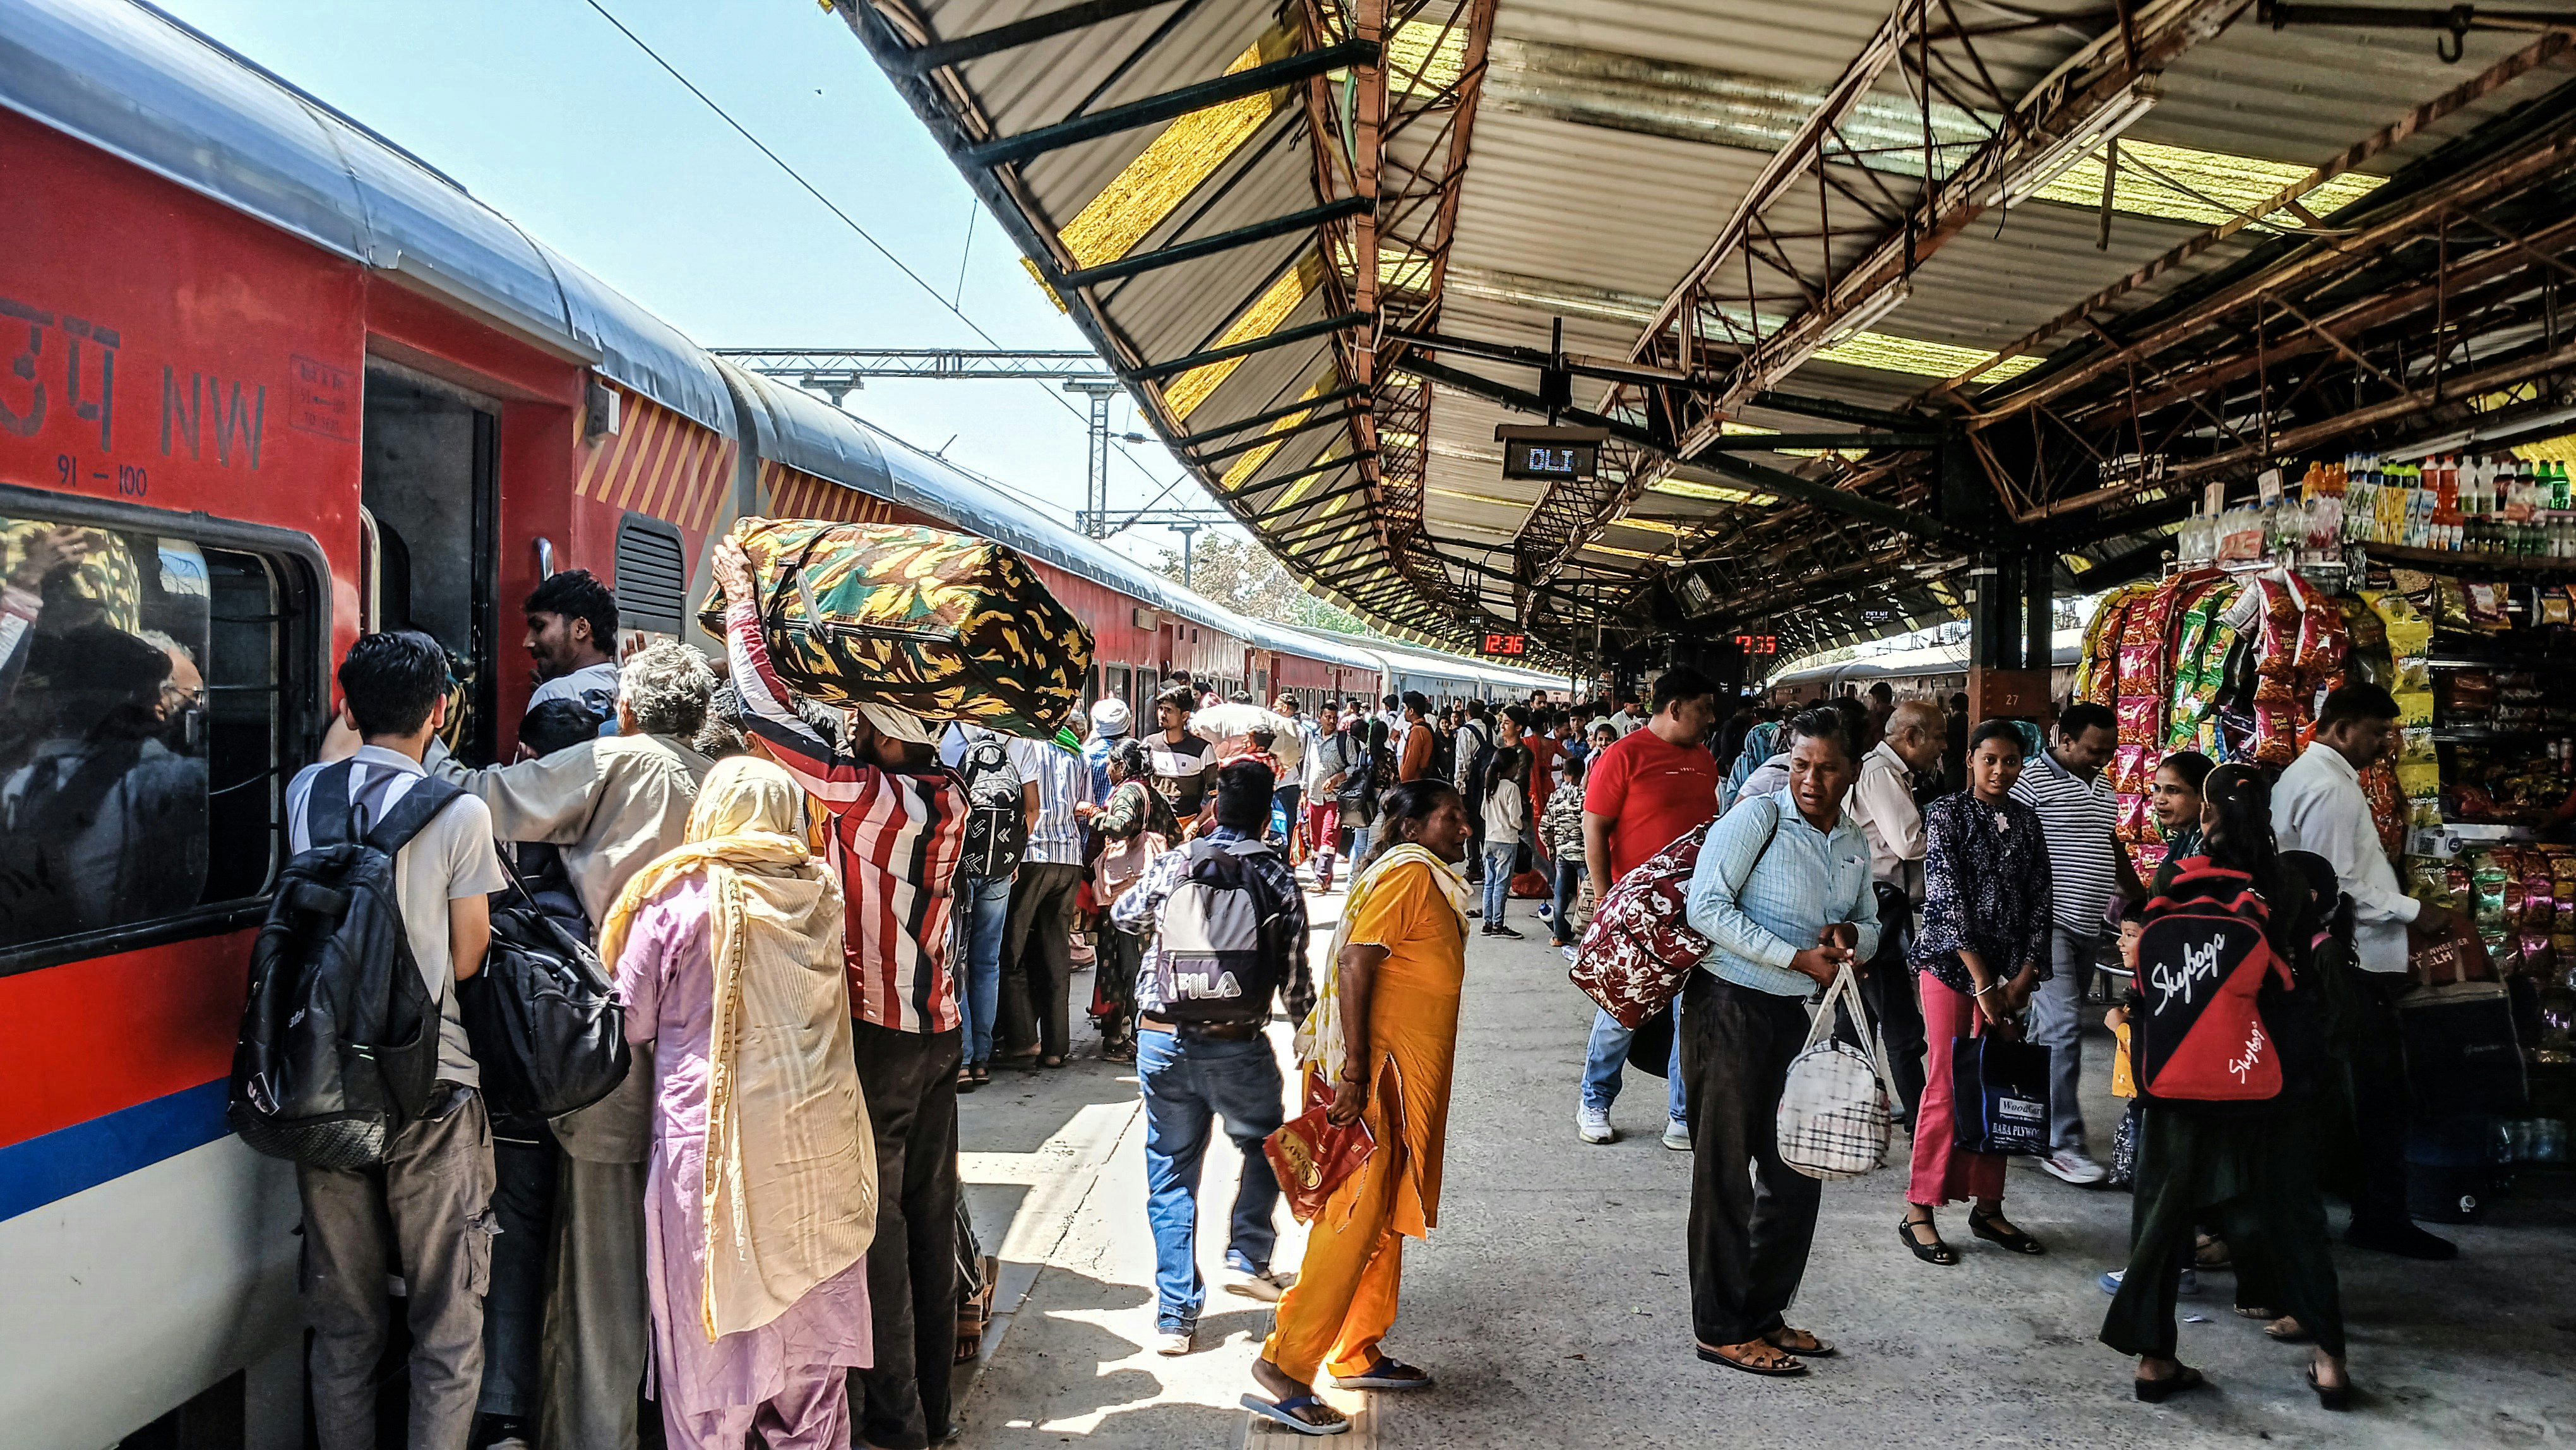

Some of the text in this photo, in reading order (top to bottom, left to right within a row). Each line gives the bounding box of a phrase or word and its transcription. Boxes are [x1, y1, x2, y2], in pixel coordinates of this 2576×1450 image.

[160, 363, 266, 470] NW
[57, 453, 76, 488] 91
[119, 464, 148, 498] 100
[1484, 634, 1525, 654] 12:36
[2006, 694, 2019, 706] 27
[1168, 971, 1242, 1000] FILA
